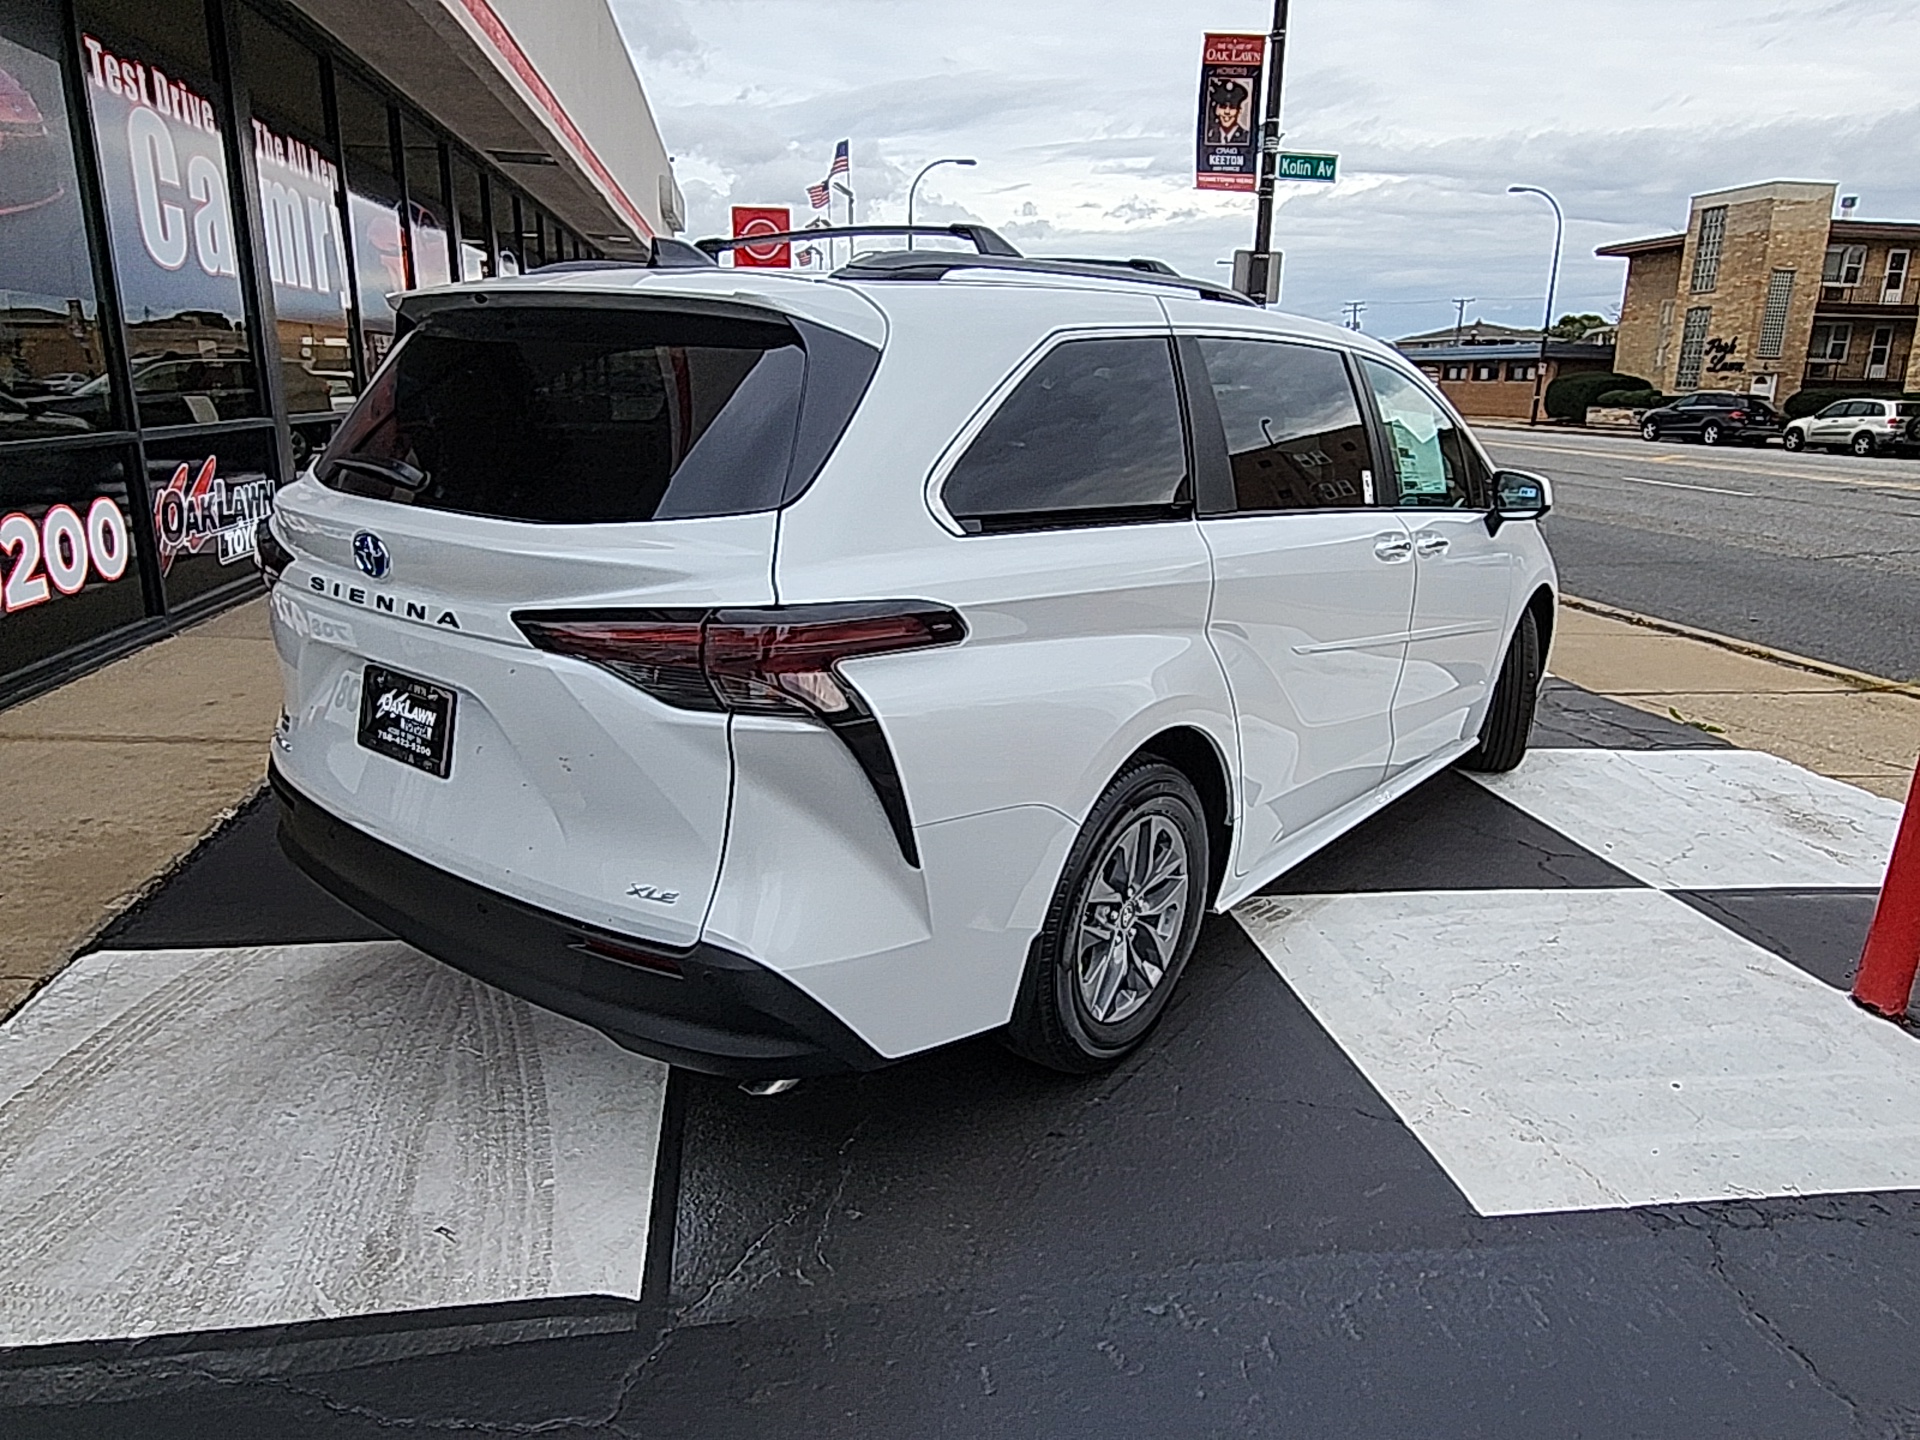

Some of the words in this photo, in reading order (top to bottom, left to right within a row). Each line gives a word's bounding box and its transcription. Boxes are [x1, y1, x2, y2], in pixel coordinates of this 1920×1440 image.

[1206, 48, 1230, 61] OAK
[1231, 48, 1261, 62] LAWN
[83, 33, 152, 106] Test
[151, 66, 217, 134] Drive
[251, 117, 285, 169] The
[1208, 154, 1244, 166] KEETON
[1280, 157, 1312, 177] Kolin
[1316, 159, 1334, 178] Av
[0, 496, 128, 613] 200
[310, 575, 462, 630] SIENNA
[625, 881, 680, 904] XLE
